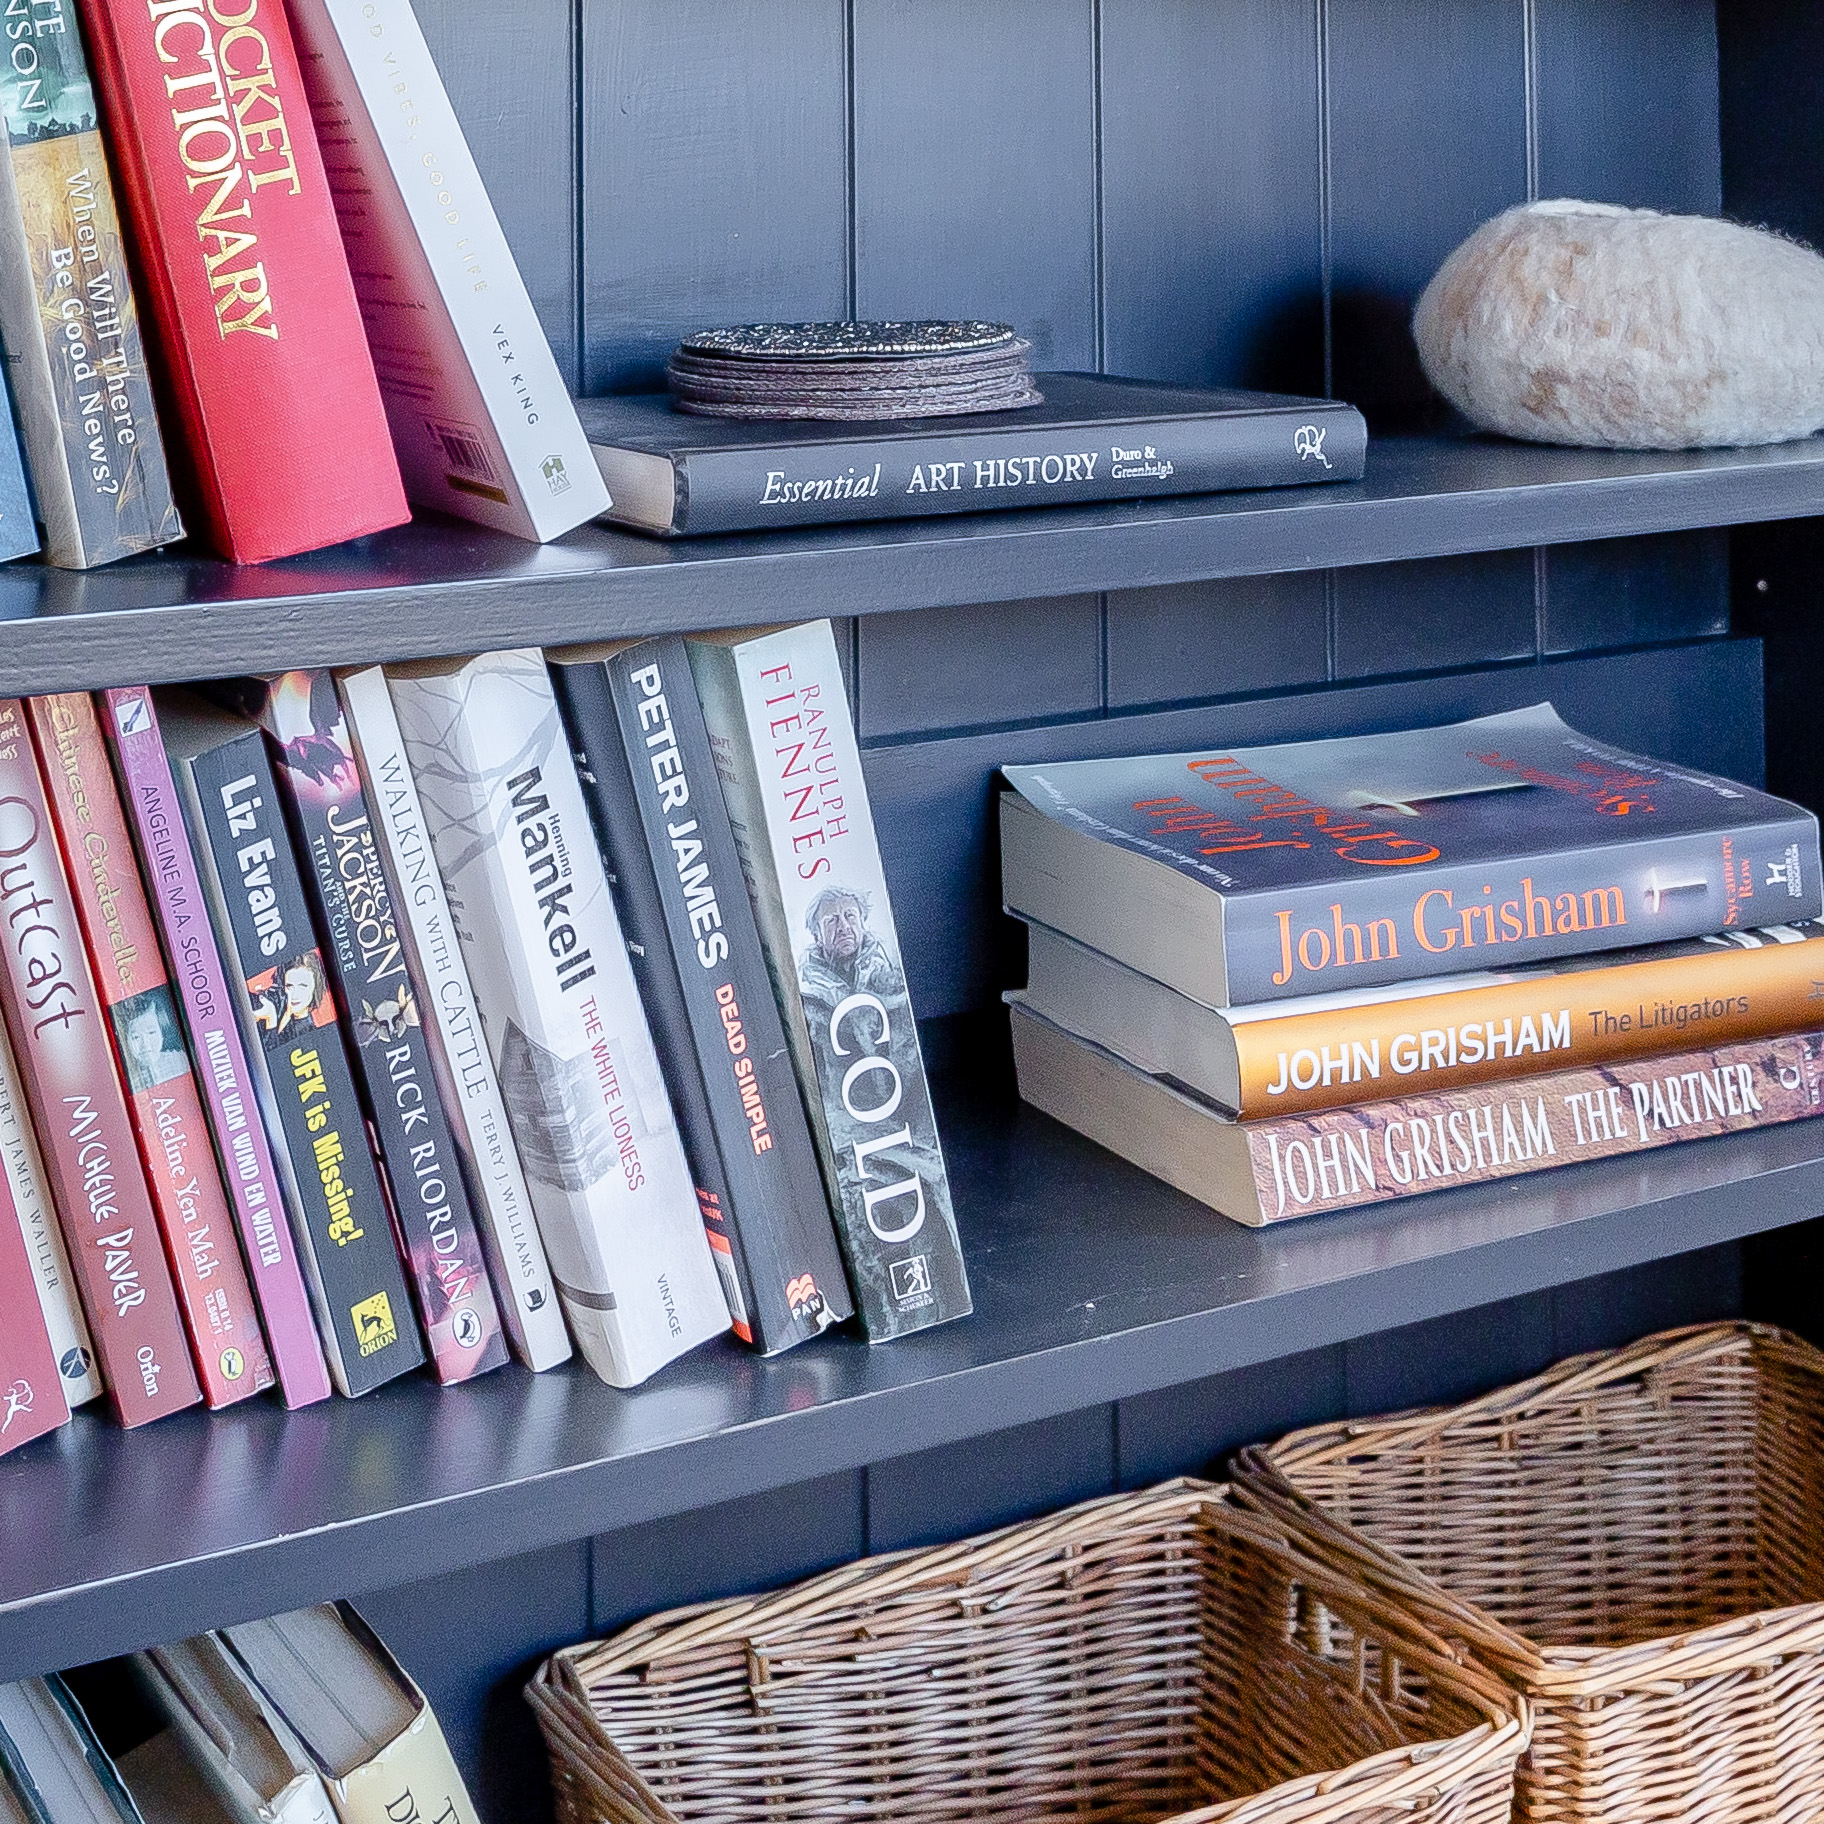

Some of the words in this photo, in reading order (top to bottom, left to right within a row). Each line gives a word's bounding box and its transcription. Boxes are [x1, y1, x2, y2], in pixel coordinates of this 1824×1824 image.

[66, 167, 100, 265] When
[51, 246, 76, 290] Be
[87, 270, 122, 341] Will
[60, 298, 88, 383] Good
[492, 322, 516, 366] VEX
[510, 373, 540, 426] KING
[101, 345, 137, 447] There
[78, 390, 119, 496] News?
[759, 463, 882, 505] Essential
[906, 461, 966, 494] ART
[972, 452, 1100, 490] HISTORY
[1110, 446, 1142, 463] Duro
[220, 773, 264, 840] Liz
[759, 662, 831, 880] FIENNES
[799, 683, 850, 840] RANULPH
[548, 812, 573, 878] Henning
[630, 662, 690, 815] PETER
[667, 819, 730, 970] JAMES
[141, 785, 181, 883] ANGELINE
[180, 935, 216, 1020] SCHOOR
[236, 836, 288, 958] Evans
[312, 834, 341, 908] TITAN'S
[331, 912, 357, 973] CURSE
[327, 804, 407, 985] JACKSON
[506, 764, 598, 994] Mankell
[1721, 835, 1740, 927] Sycamore
[1738, 857, 1754, 899] Row
[379, 750, 437, 908] WALKING
[425, 914, 452, 974] WITH
[440, 979, 487, 1100] CATTLE
[1272, 903, 1401, 986] John
[1413, 876, 1629, 954] Grisham
[1266, 1038, 1382, 1097] JOHN
[1388, 1009, 1572, 1076] GRISHAM
[1587, 1009, 1632, 1037] The
[1638, 993, 1750, 1033] Litigators
[204, 1029, 236, 1101] MUZIEK
[290, 1047, 327, 1108] JFK
[579, 994, 603, 1041] THE
[591, 1037, 623, 1106] WHITE
[608, 1104, 645, 1192] LIONESS
[715, 982, 749, 1055] DEAD
[734, 1056, 773, 1156] SIMPLE
[152, 1095, 186, 1181] Adeline
[220, 1095, 246, 1133] VAN
[230, 1129, 261, 1182] WIND
[829, 992, 927, 1243] COLD
[1264, 1125, 1378, 1218] JOHN
[1383, 1095, 1558, 1186] GRISHAM
[4, 1136, 36, 1201] JAMES
[29, 1207, 62, 1292] WALLER
[62, 1094, 119, 1224] MICHELLE
[96, 1226, 147, 1317] PAVER
[175, 1176, 201, 1225] Yen
[242, 1180, 267, 1209] EN
[384, 1040, 430, 1137] RICK
[410, 1140, 474, 1306] RIORDAN
[478, 1108, 506, 1168] TERRY
[500, 1185, 536, 1279] WILLIAMS
[186, 1224, 215, 1282] Mah
[249, 1207, 282, 1269] WATER
[358, 1329, 398, 1360] ORION
[656, 1272, 683, 1339] VINTAGE
[792, 1296, 822, 1322] PAN
[135, 1345, 162, 1399] Orion
